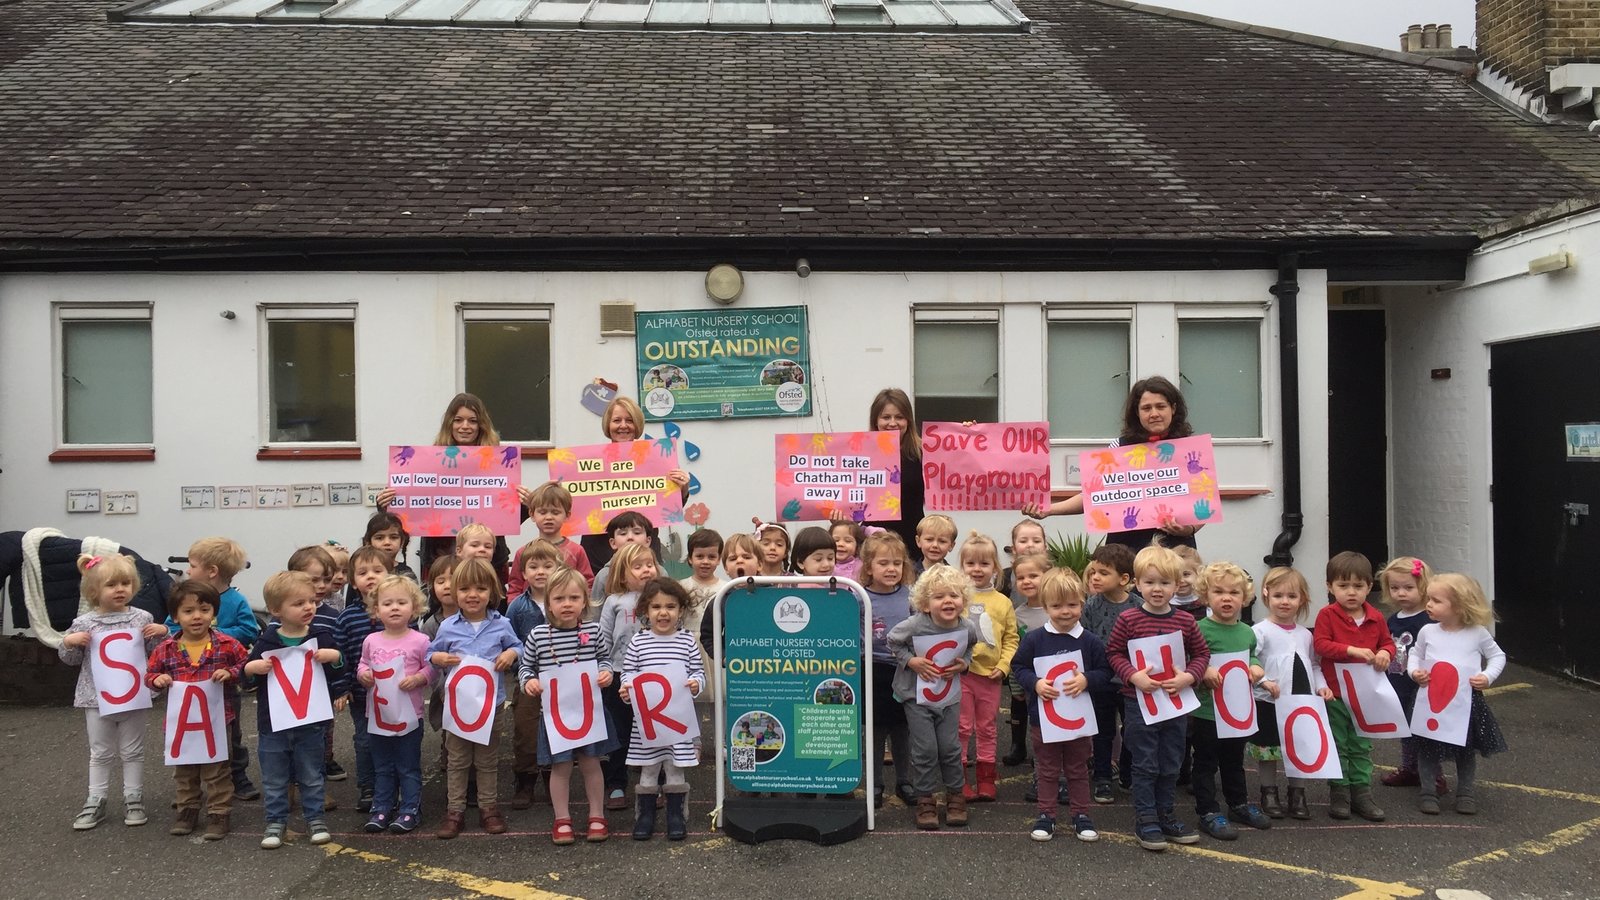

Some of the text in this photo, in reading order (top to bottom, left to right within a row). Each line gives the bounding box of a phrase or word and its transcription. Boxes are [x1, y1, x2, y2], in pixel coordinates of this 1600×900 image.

[645, 313, 799, 329] ALPHABET NURSERY SCHOOL
[686, 328, 760, 338] Ofsted rated us
[644, 336, 800, 360] OUTSTANDING
[923, 425, 1049, 454] Save OUR
[579, 460, 633, 471] We are
[789, 455, 869, 468] Do not take
[392, 475, 410, 484] We
[414, 475, 437, 484] love
[465, 478, 507, 487] nursery,
[795, 472, 882, 485] Chatham Hall
[924, 462, 1050, 496] Playground
[1103, 468, 1178, 483] We love our
[568, 478, 665, 493] OUTSTANDING
[295, 494, 301, 503] 7
[332, 494, 339, 502] 8
[368, 494, 374, 503] 9
[807, 488, 840, 499] away
[1092, 484, 1186, 502] outdoor space.
[185, 497, 192, 506] 4
[223, 497, 230, 506] 5
[259, 496, 266, 504] 6
[391, 497, 404, 506] do
[412, 497, 430, 506] not
[435, 497, 461, 506] close
[602, 495, 654, 508] nursery.
[107, 503, 114, 511] 2
[729, 638, 857, 648] ALPHABET NURSERY SCHOOL
[772, 649, 815, 658] IS OFSTED
[100, 632, 141, 705] S
[729, 659, 857, 675] OUTSTANDING
[270, 650, 313, 720] V
[550, 672, 594, 740] U
[632, 672, 688, 740] R
[1343, 669, 1397, 733] L
[170, 685, 216, 759] A
